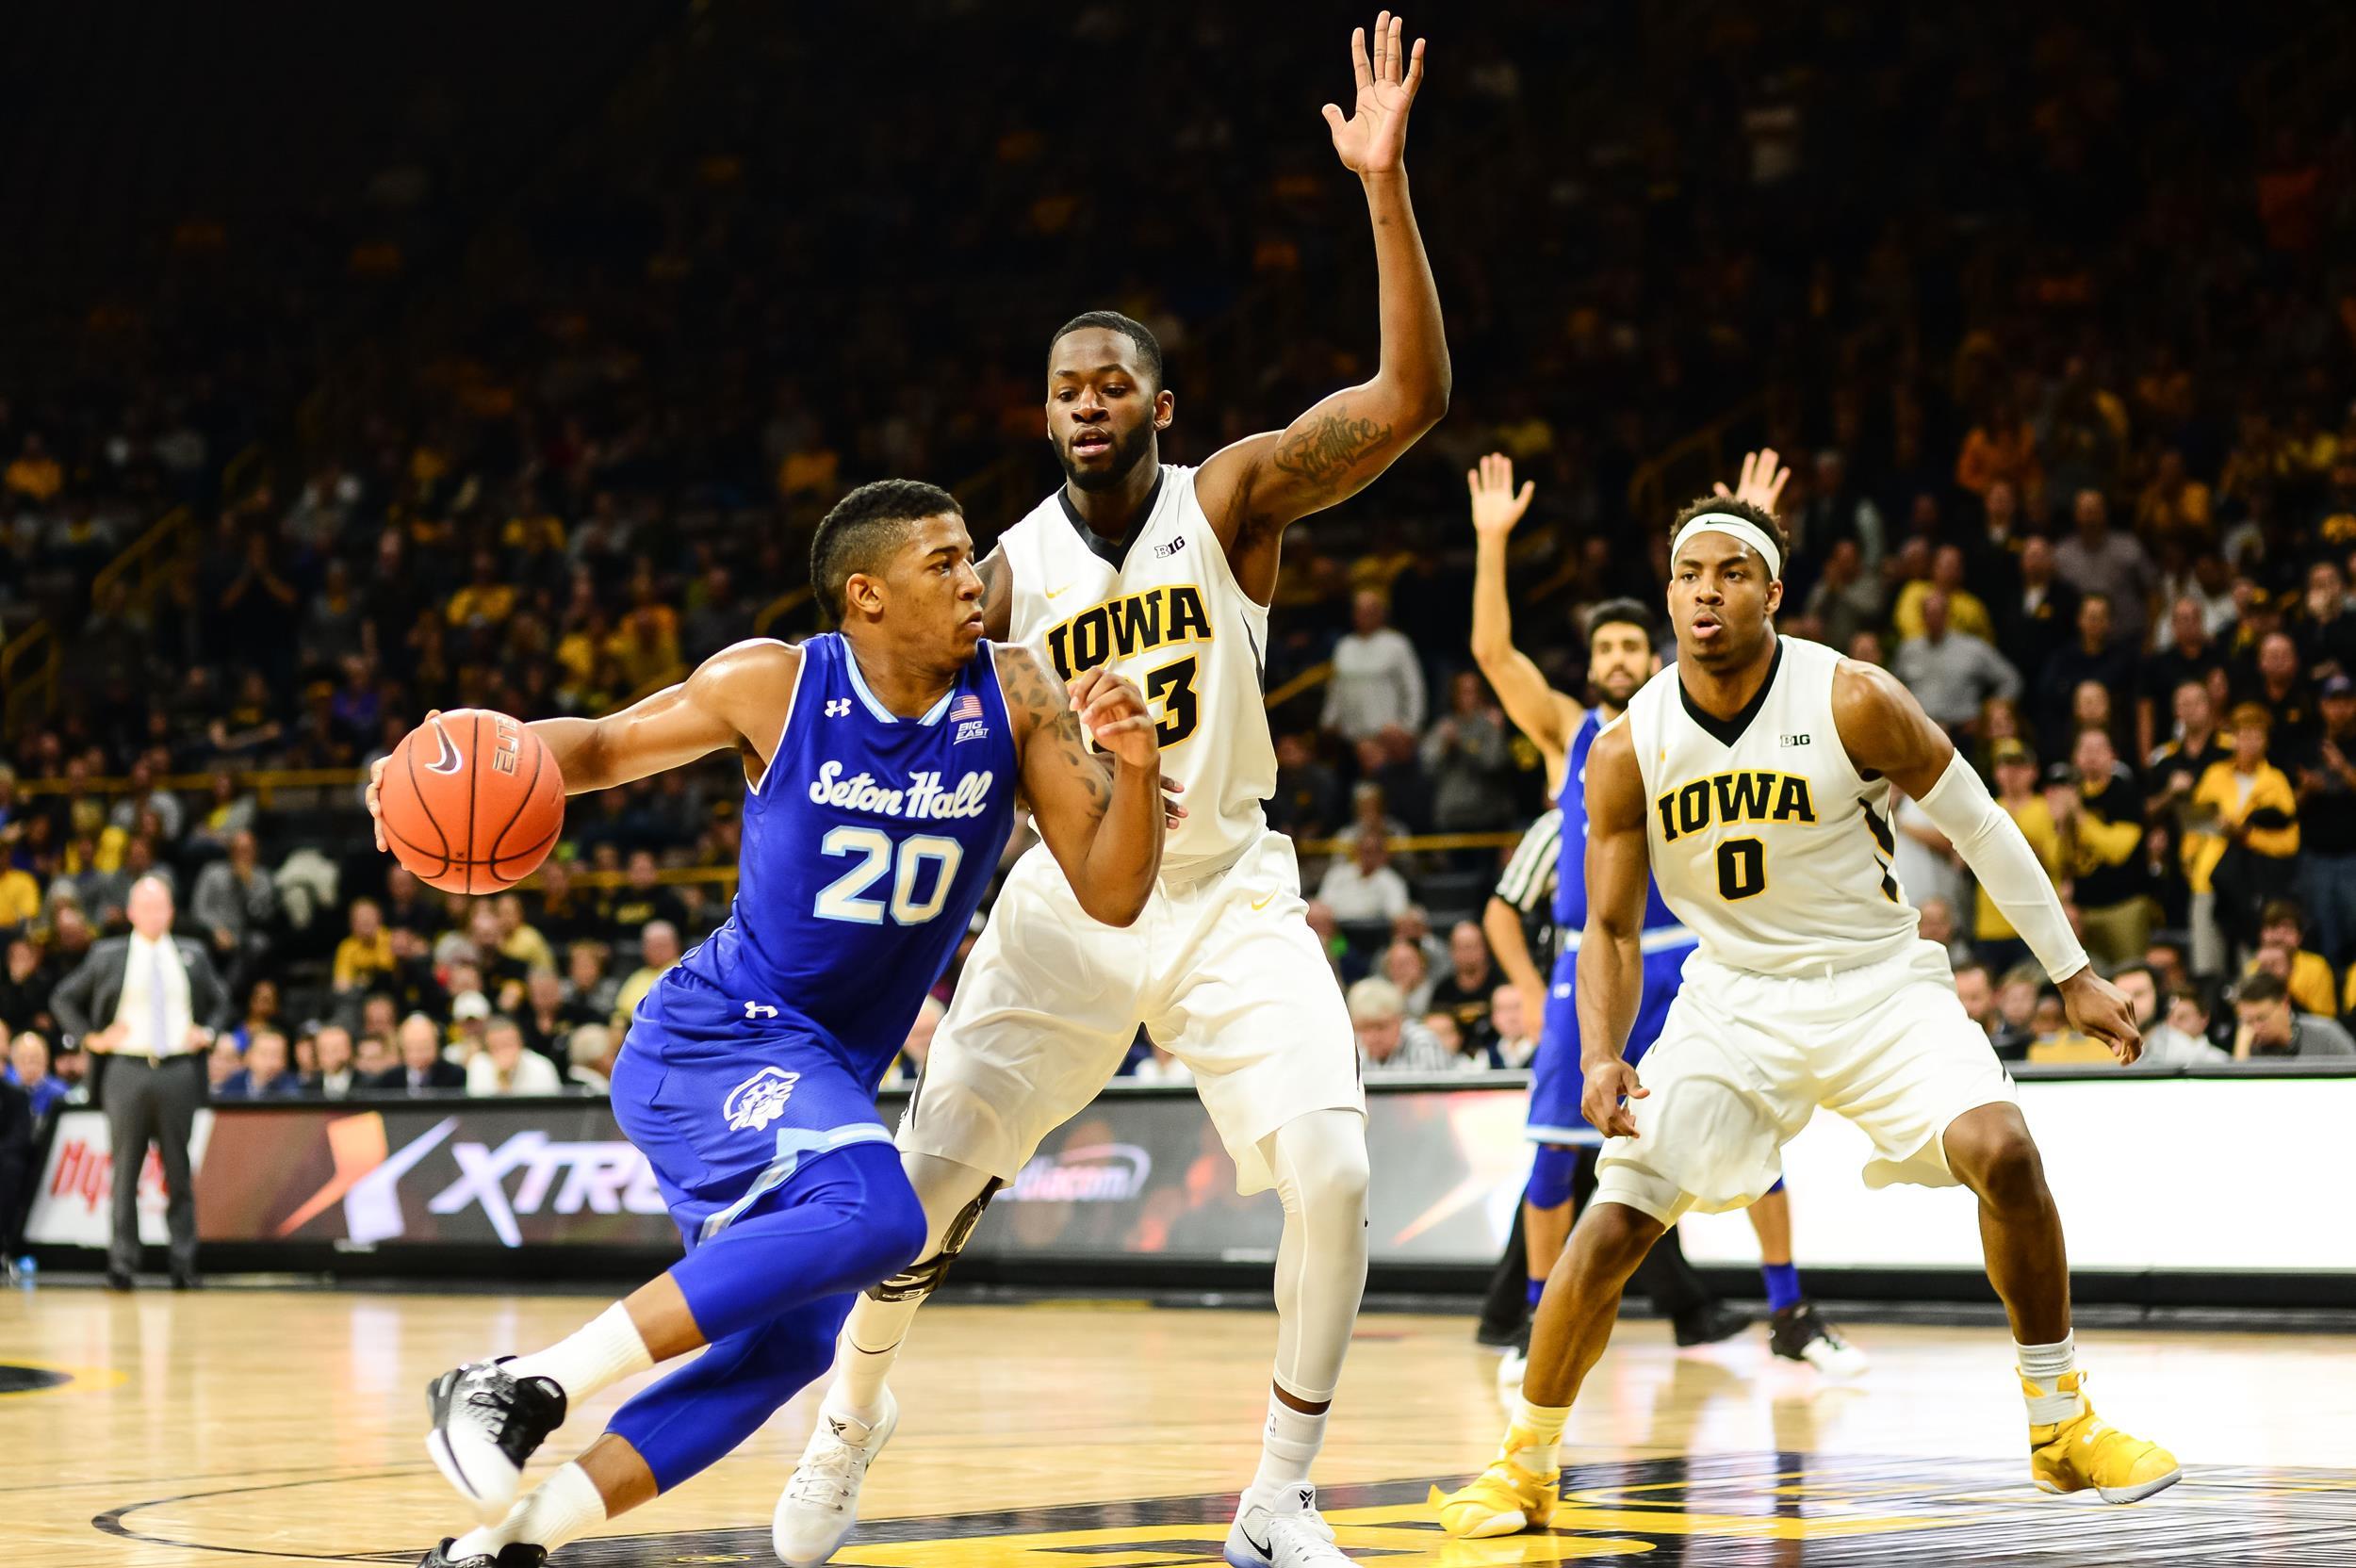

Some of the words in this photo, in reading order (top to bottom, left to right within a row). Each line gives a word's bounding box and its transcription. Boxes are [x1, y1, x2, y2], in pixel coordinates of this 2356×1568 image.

[1045, 584, 1214, 686] IOWA
[956, 728, 990, 740] EAST
[957, 721, 983, 731] BIG
[809, 760, 903, 817] Seton
[905, 770, 993, 820] Hall
[1657, 769, 1817, 843] IOWA
[813, 825, 963, 925] 20
[1714, 836, 1767, 903] 0
